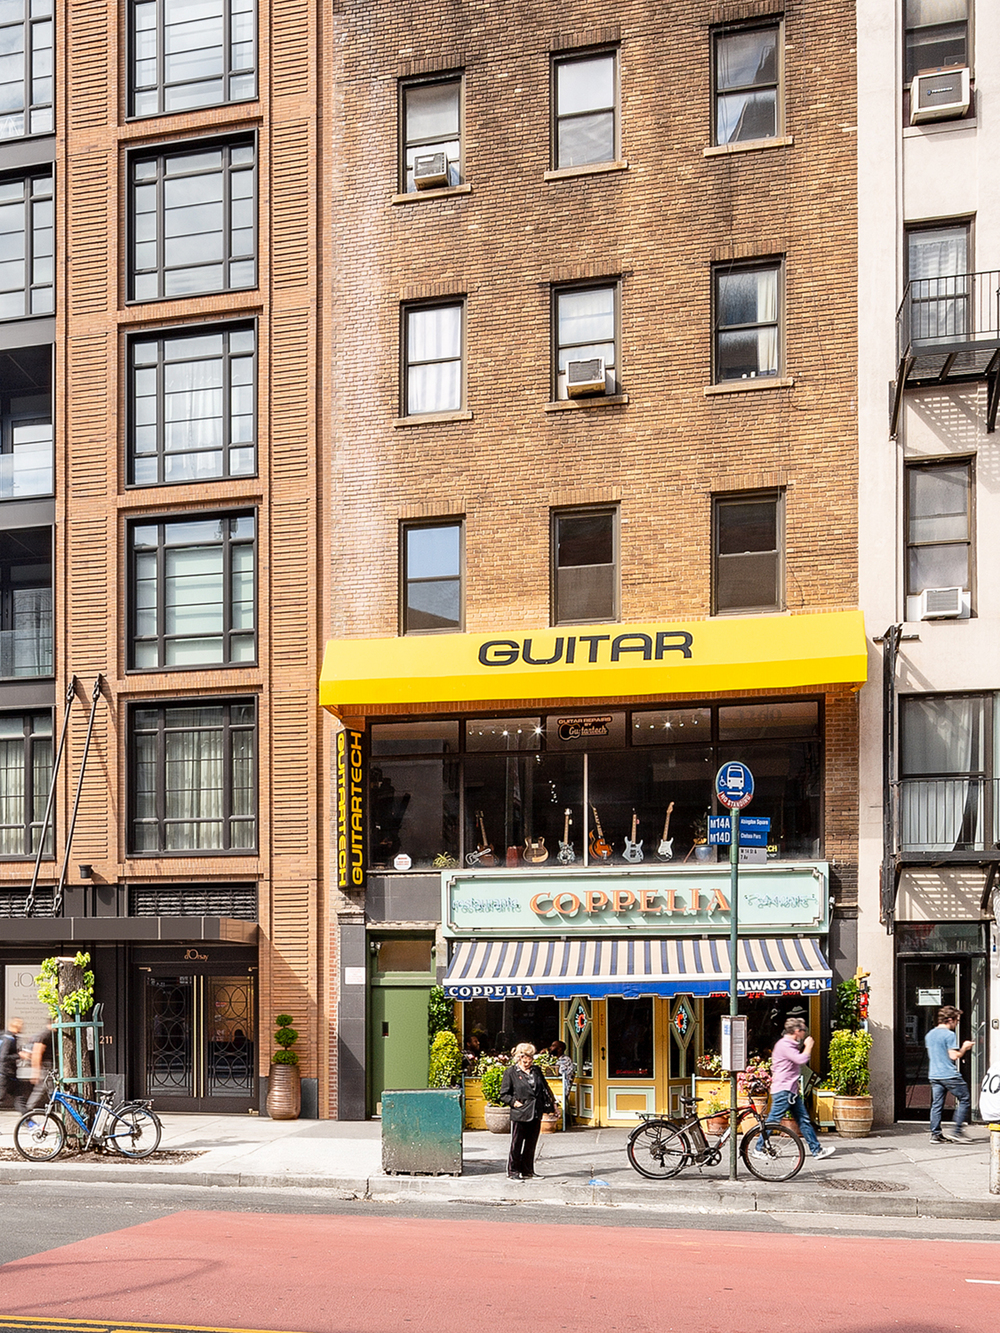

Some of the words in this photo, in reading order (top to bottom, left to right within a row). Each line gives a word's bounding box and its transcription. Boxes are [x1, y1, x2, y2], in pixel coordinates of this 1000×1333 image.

[478, 630, 693, 666] GUITAR
[720, 793, 729, 803] NO
[728, 791, 751, 807] STANDING
[337, 732, 347, 887] GUITARTECH
[350, 731, 364, 886] GUITARTECH
[710, 818, 731, 829] M14A
[710, 832, 731, 843] M14D
[530, 888, 731, 915] COPPELIA
[449, 985, 535, 997] COPPELIA
[737, 979, 787, 991] ALWAYS
[789, 979, 826, 990] OPEN
[100, 1036, 113, 1044] 211
